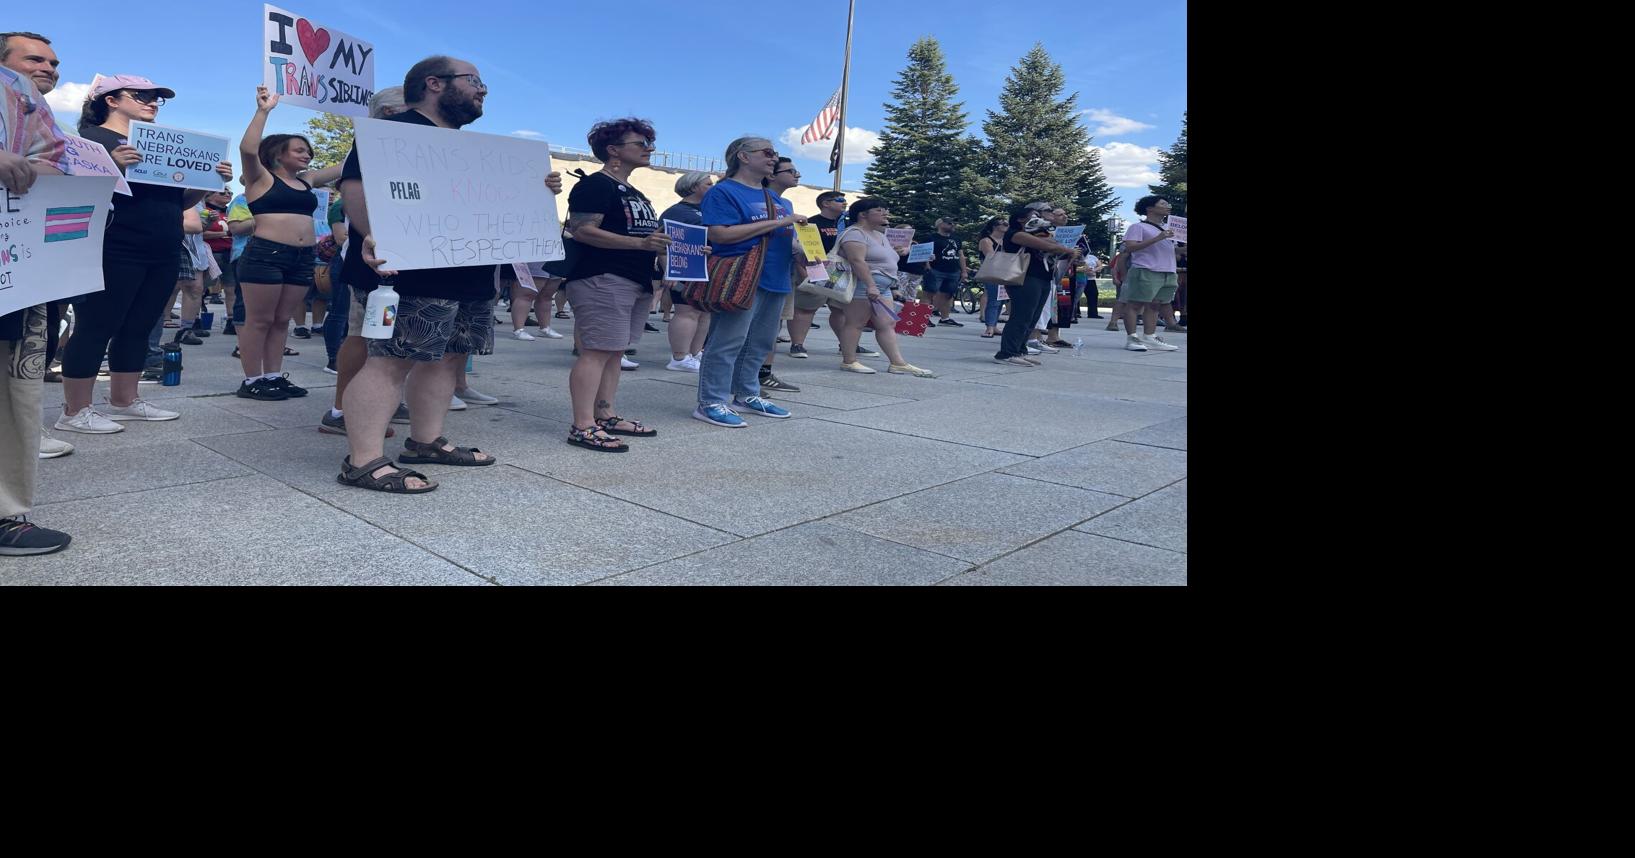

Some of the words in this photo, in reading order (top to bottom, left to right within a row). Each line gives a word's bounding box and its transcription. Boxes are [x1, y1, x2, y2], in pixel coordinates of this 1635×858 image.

[269, 12, 294, 55] I
[329, 38, 373, 76] MY
[269, 56, 328, 104] TRANS
[137, 127, 185, 144] TRANS
[136, 140, 220, 162] NEBRASKANS
[377, 136, 470, 172] TRANS
[480, 149, 540, 180] KIDS
[140, 153, 163, 165] RE
[167, 158, 212, 172] LOVED
[389, 181, 421, 200] PFLAG
[451, 176, 521, 206] KNOW
[395, 213, 460, 236] WHO
[472, 212, 525, 235] THEY
[668, 225, 685, 240] TRANS
[21, 243, 32, 259] is
[429, 236, 528, 267] RESPECT
[525, 237, 564, 256] THEM!
[670, 255, 688, 269] BELONG
